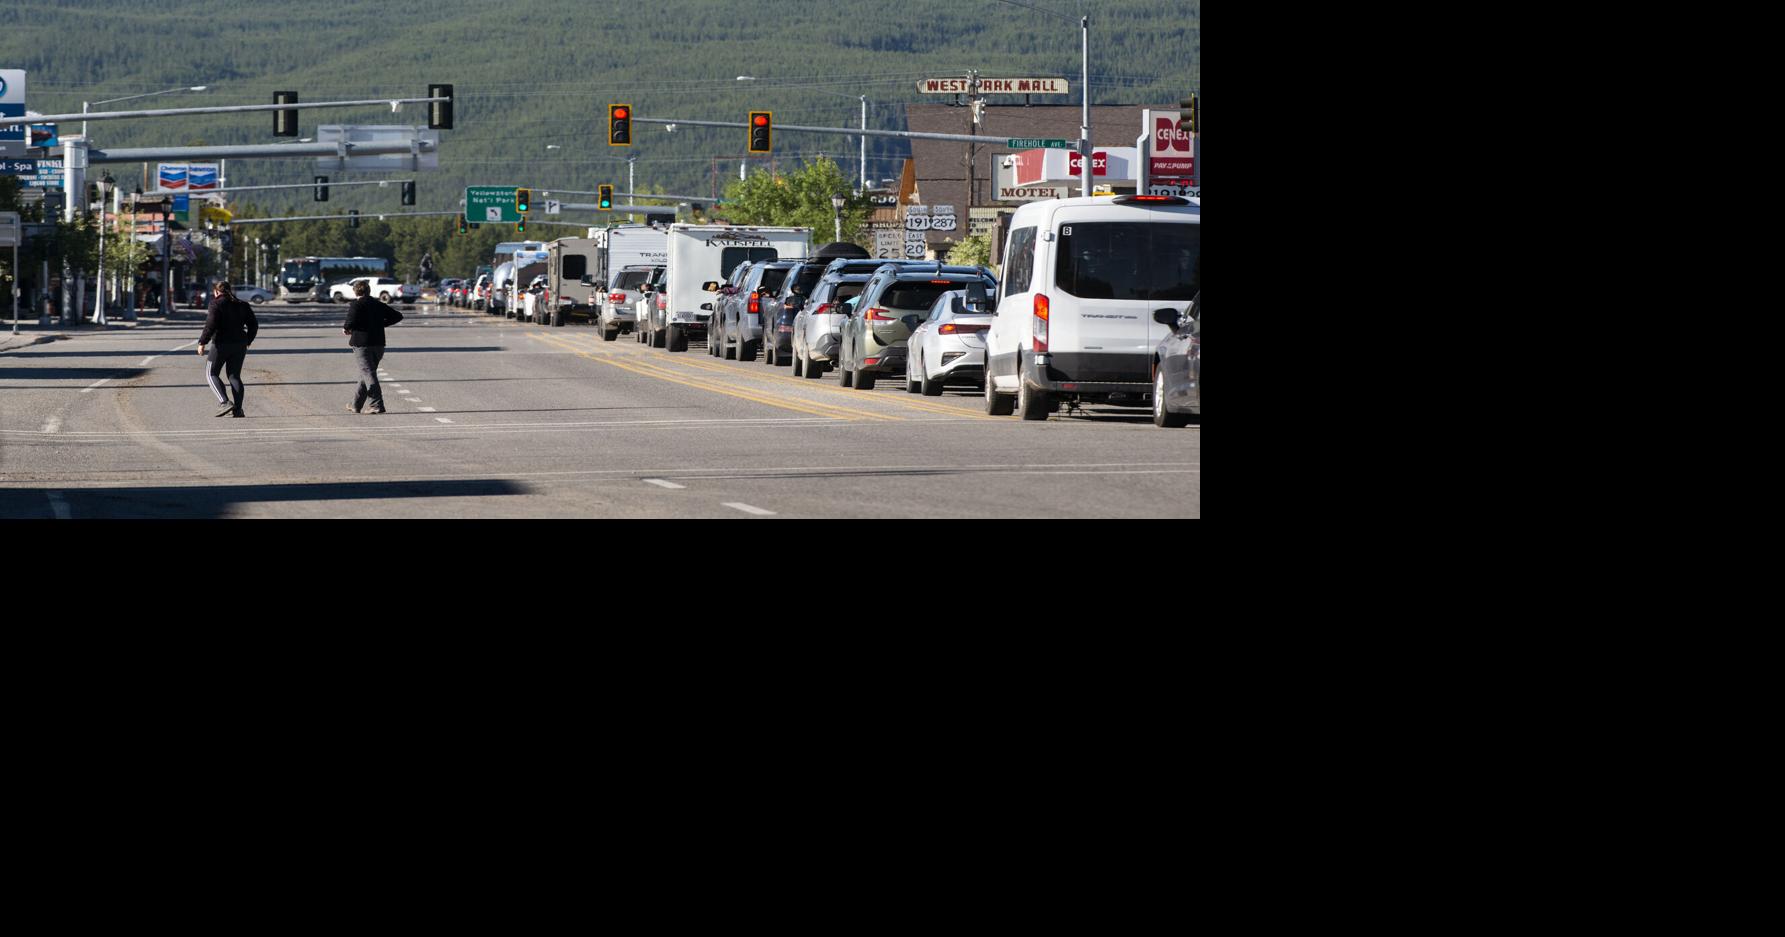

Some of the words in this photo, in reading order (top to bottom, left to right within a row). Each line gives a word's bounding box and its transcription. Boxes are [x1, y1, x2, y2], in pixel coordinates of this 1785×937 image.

[927, 80, 967, 91] WEST
[977, 80, 1012, 91] PARK
[1018, 80, 1058, 92] MALL
[1157, 128, 1189, 140] CENEX
[1012, 139, 1046, 148] FIREHOLE
[14, 162, 32, 171] Spa
[1070, 158, 1106, 168] CEEX
[1001, 187, 1058, 197] MOTEL
[909, 218, 928, 227] 191
[933, 218, 953, 227] 287
[1064, 227, 1071, 235] B
[705, 239, 775, 248] KALISPELL
[879, 248, 900, 258] 25
[906, 244, 923, 254] 20
